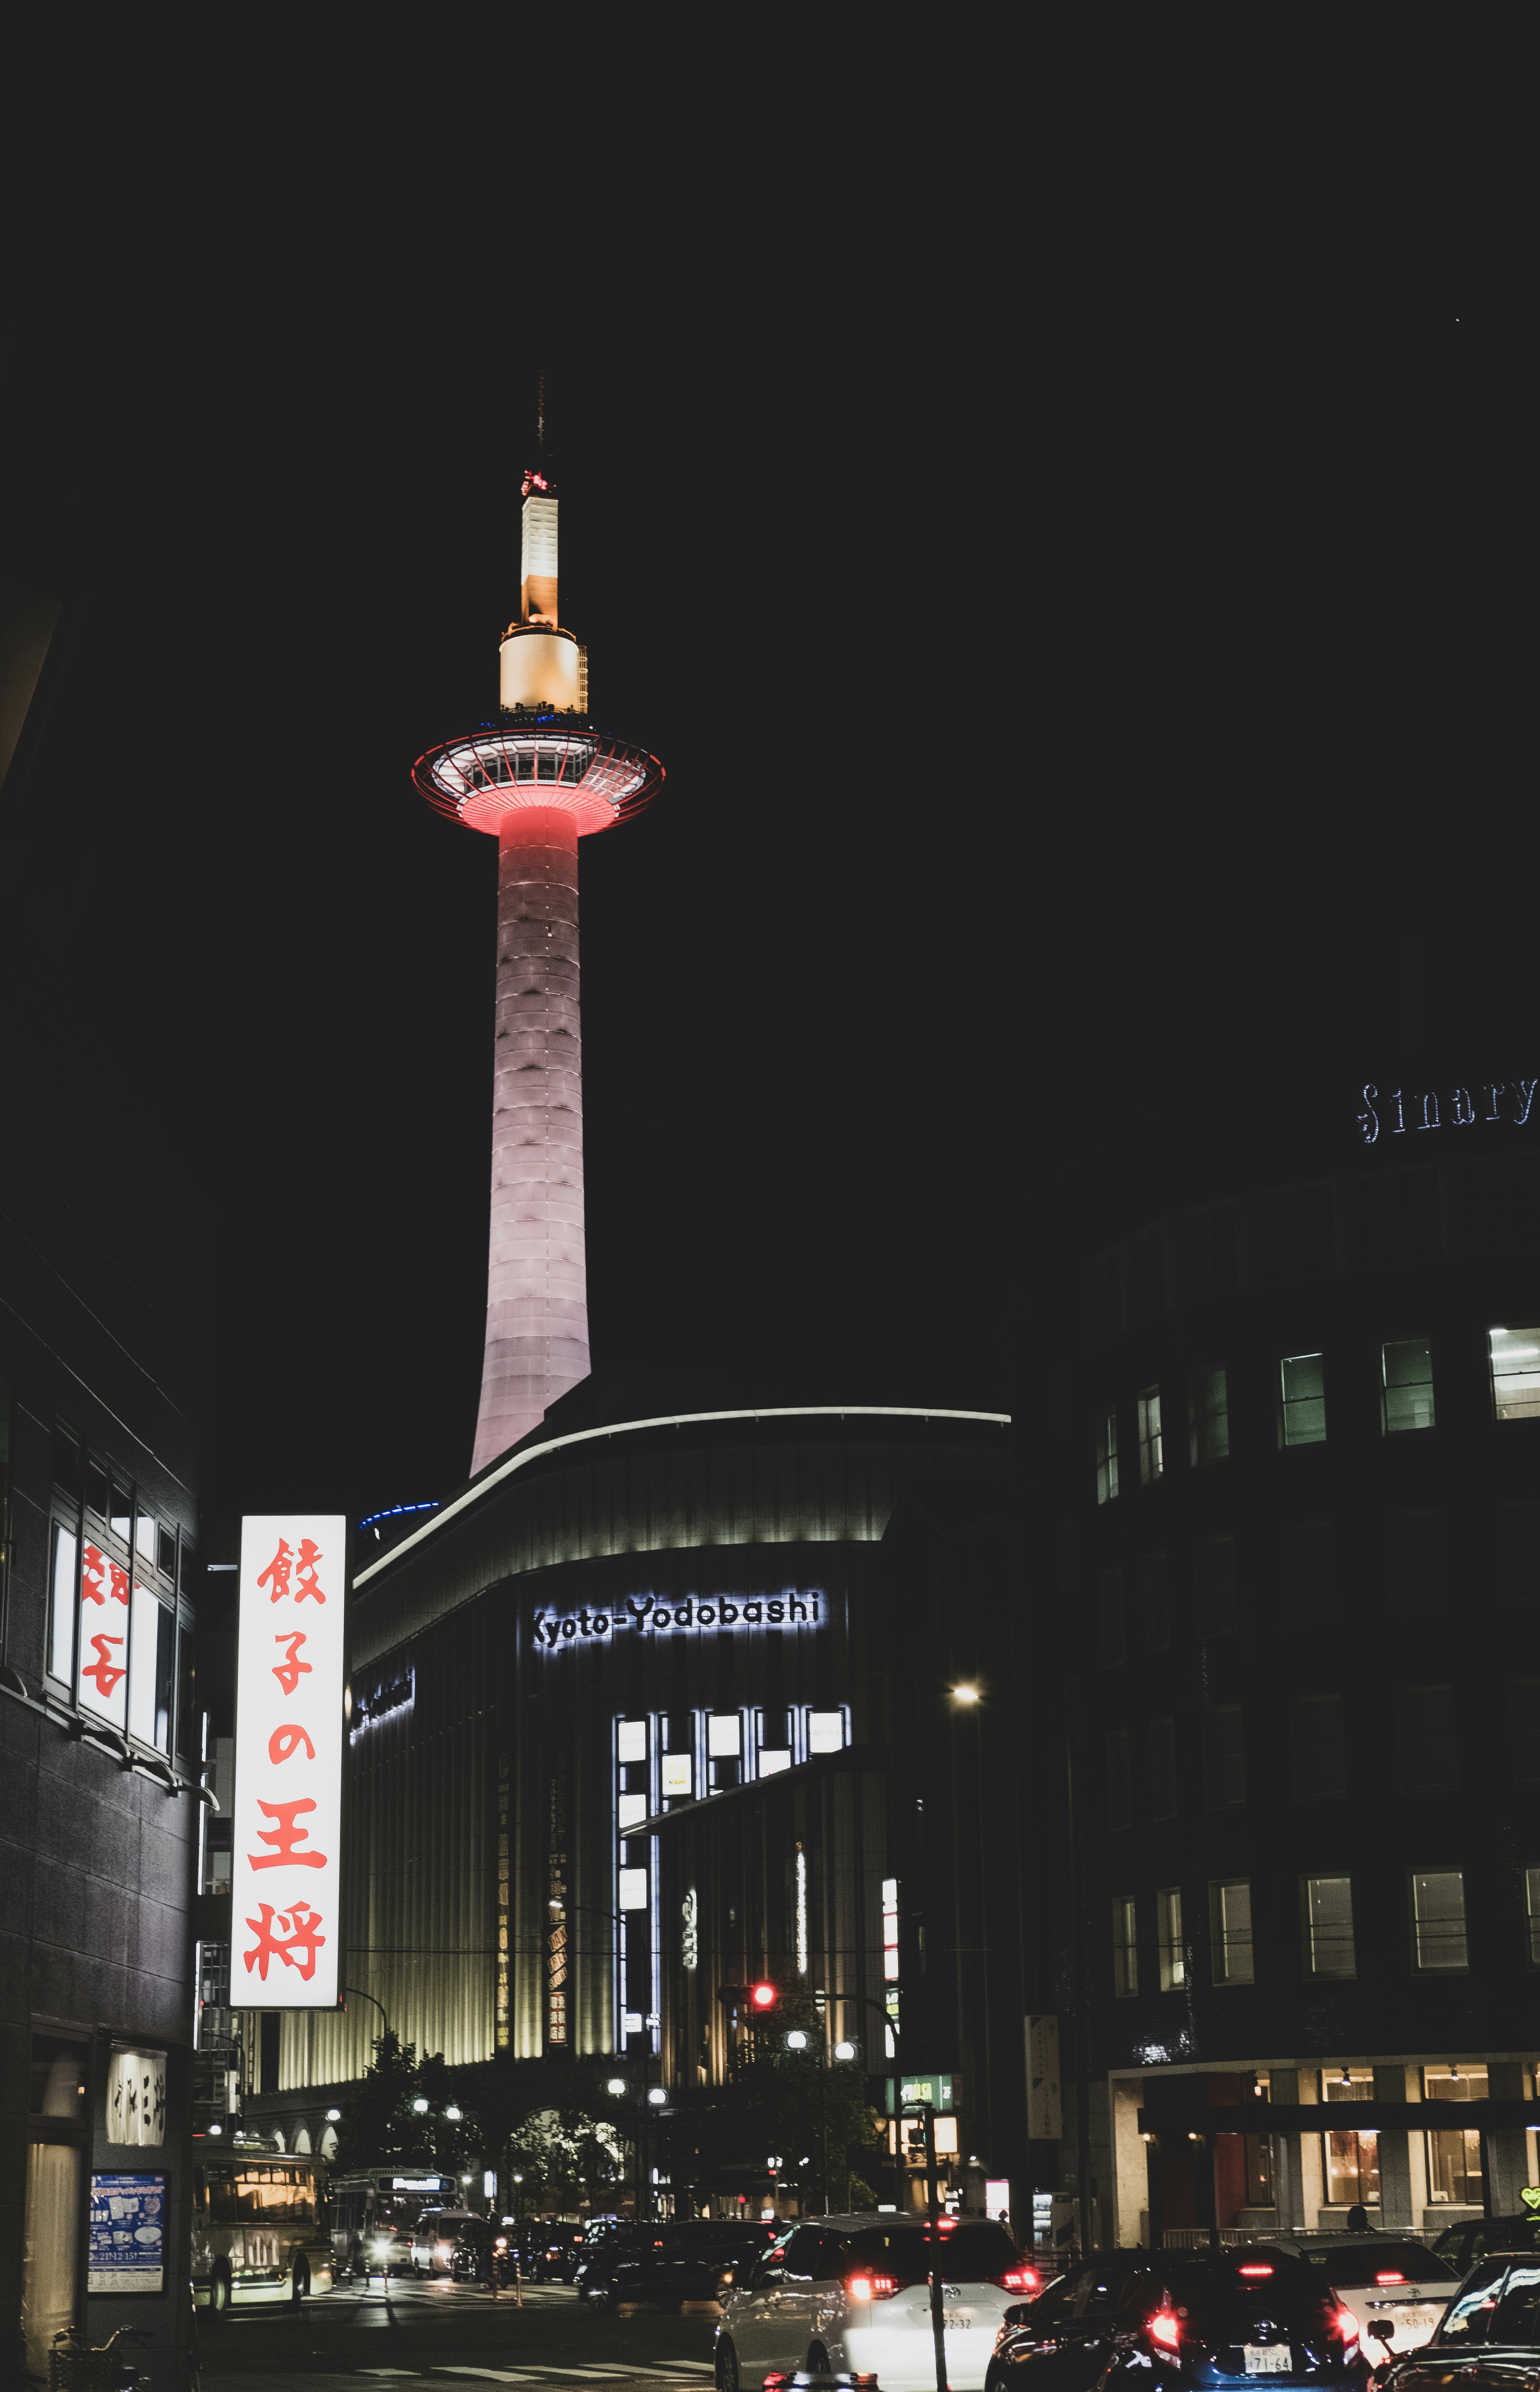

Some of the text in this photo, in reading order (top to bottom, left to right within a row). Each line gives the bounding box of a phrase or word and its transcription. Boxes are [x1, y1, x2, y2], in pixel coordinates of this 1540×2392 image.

[1356, 1078, 1538, 1144] Sinary
[530, 1591, 819, 1648] Kyoto-Yodobashi
[243, 1538, 327, 1981] 餃子の王将
[1406, 2317, 1435, 2330] 50-19
[1255, 2357, 1288, 2371] 71-64
